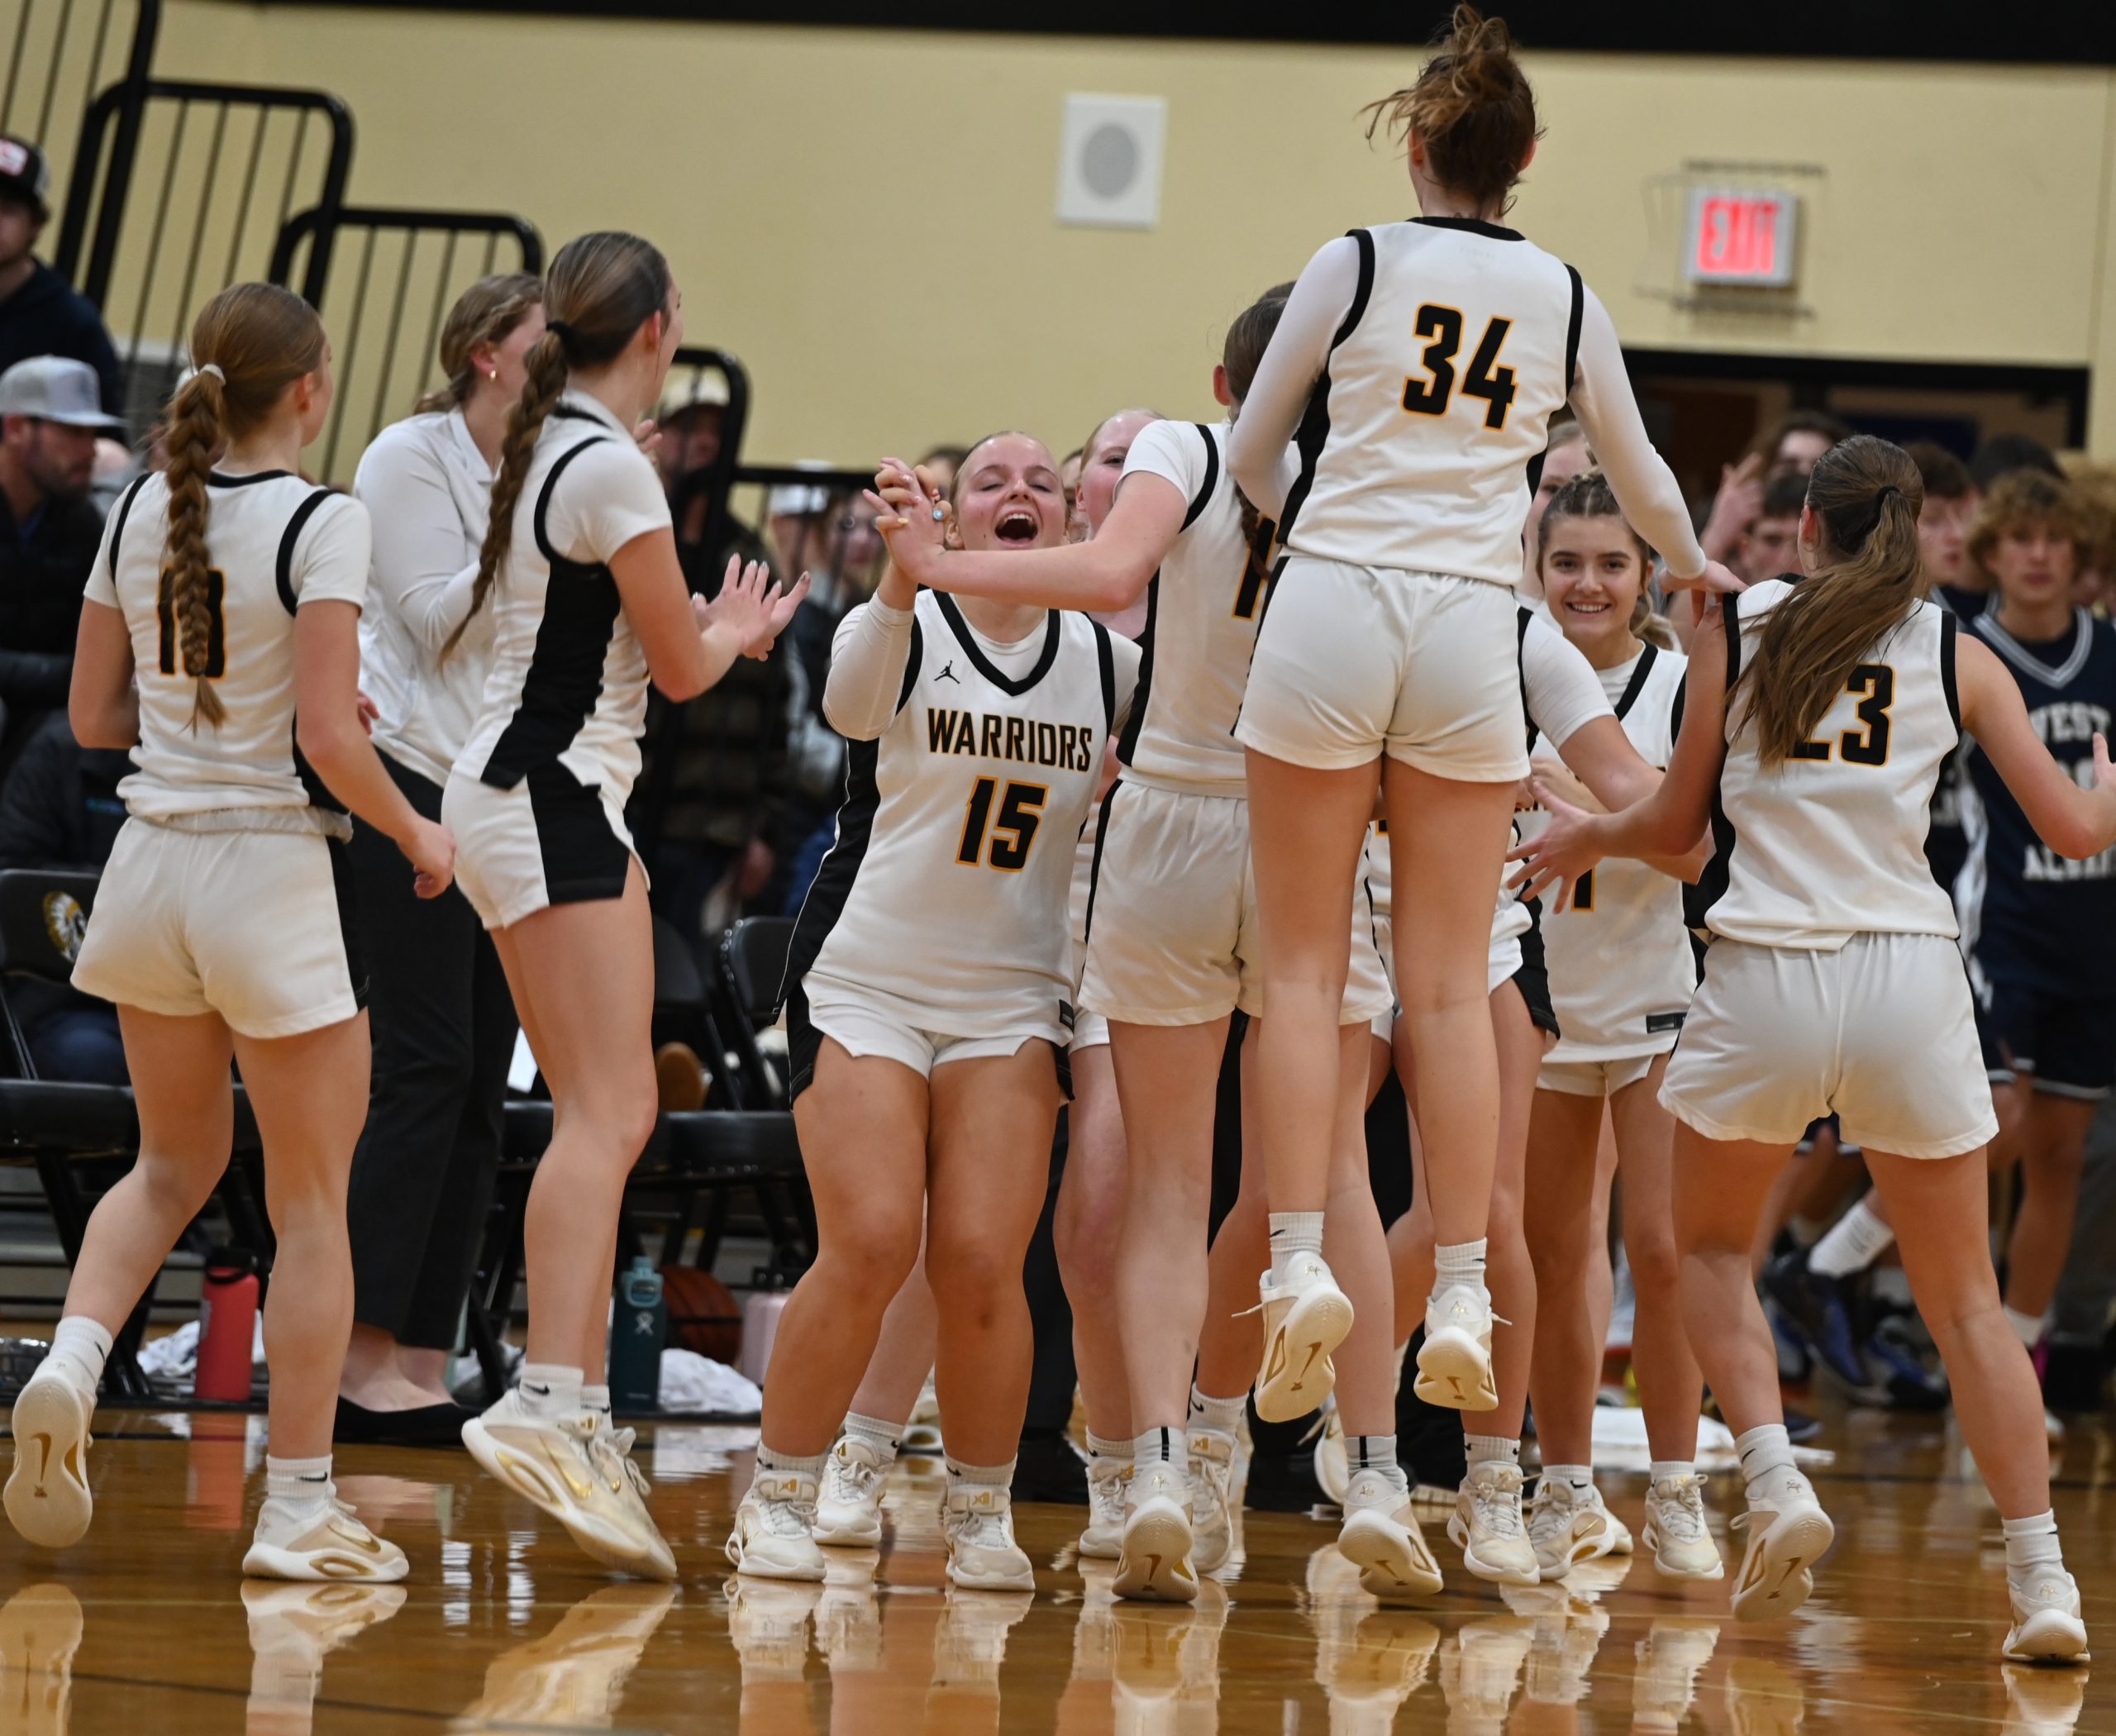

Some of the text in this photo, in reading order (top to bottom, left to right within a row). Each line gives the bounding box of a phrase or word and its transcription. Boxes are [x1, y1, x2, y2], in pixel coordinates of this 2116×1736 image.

[1697, 198, 1780, 274] EXIT
[1400, 302, 1518, 432] 34
[927, 707, 1093, 772] WARRIORS
[955, 775, 1050, 873] 15
